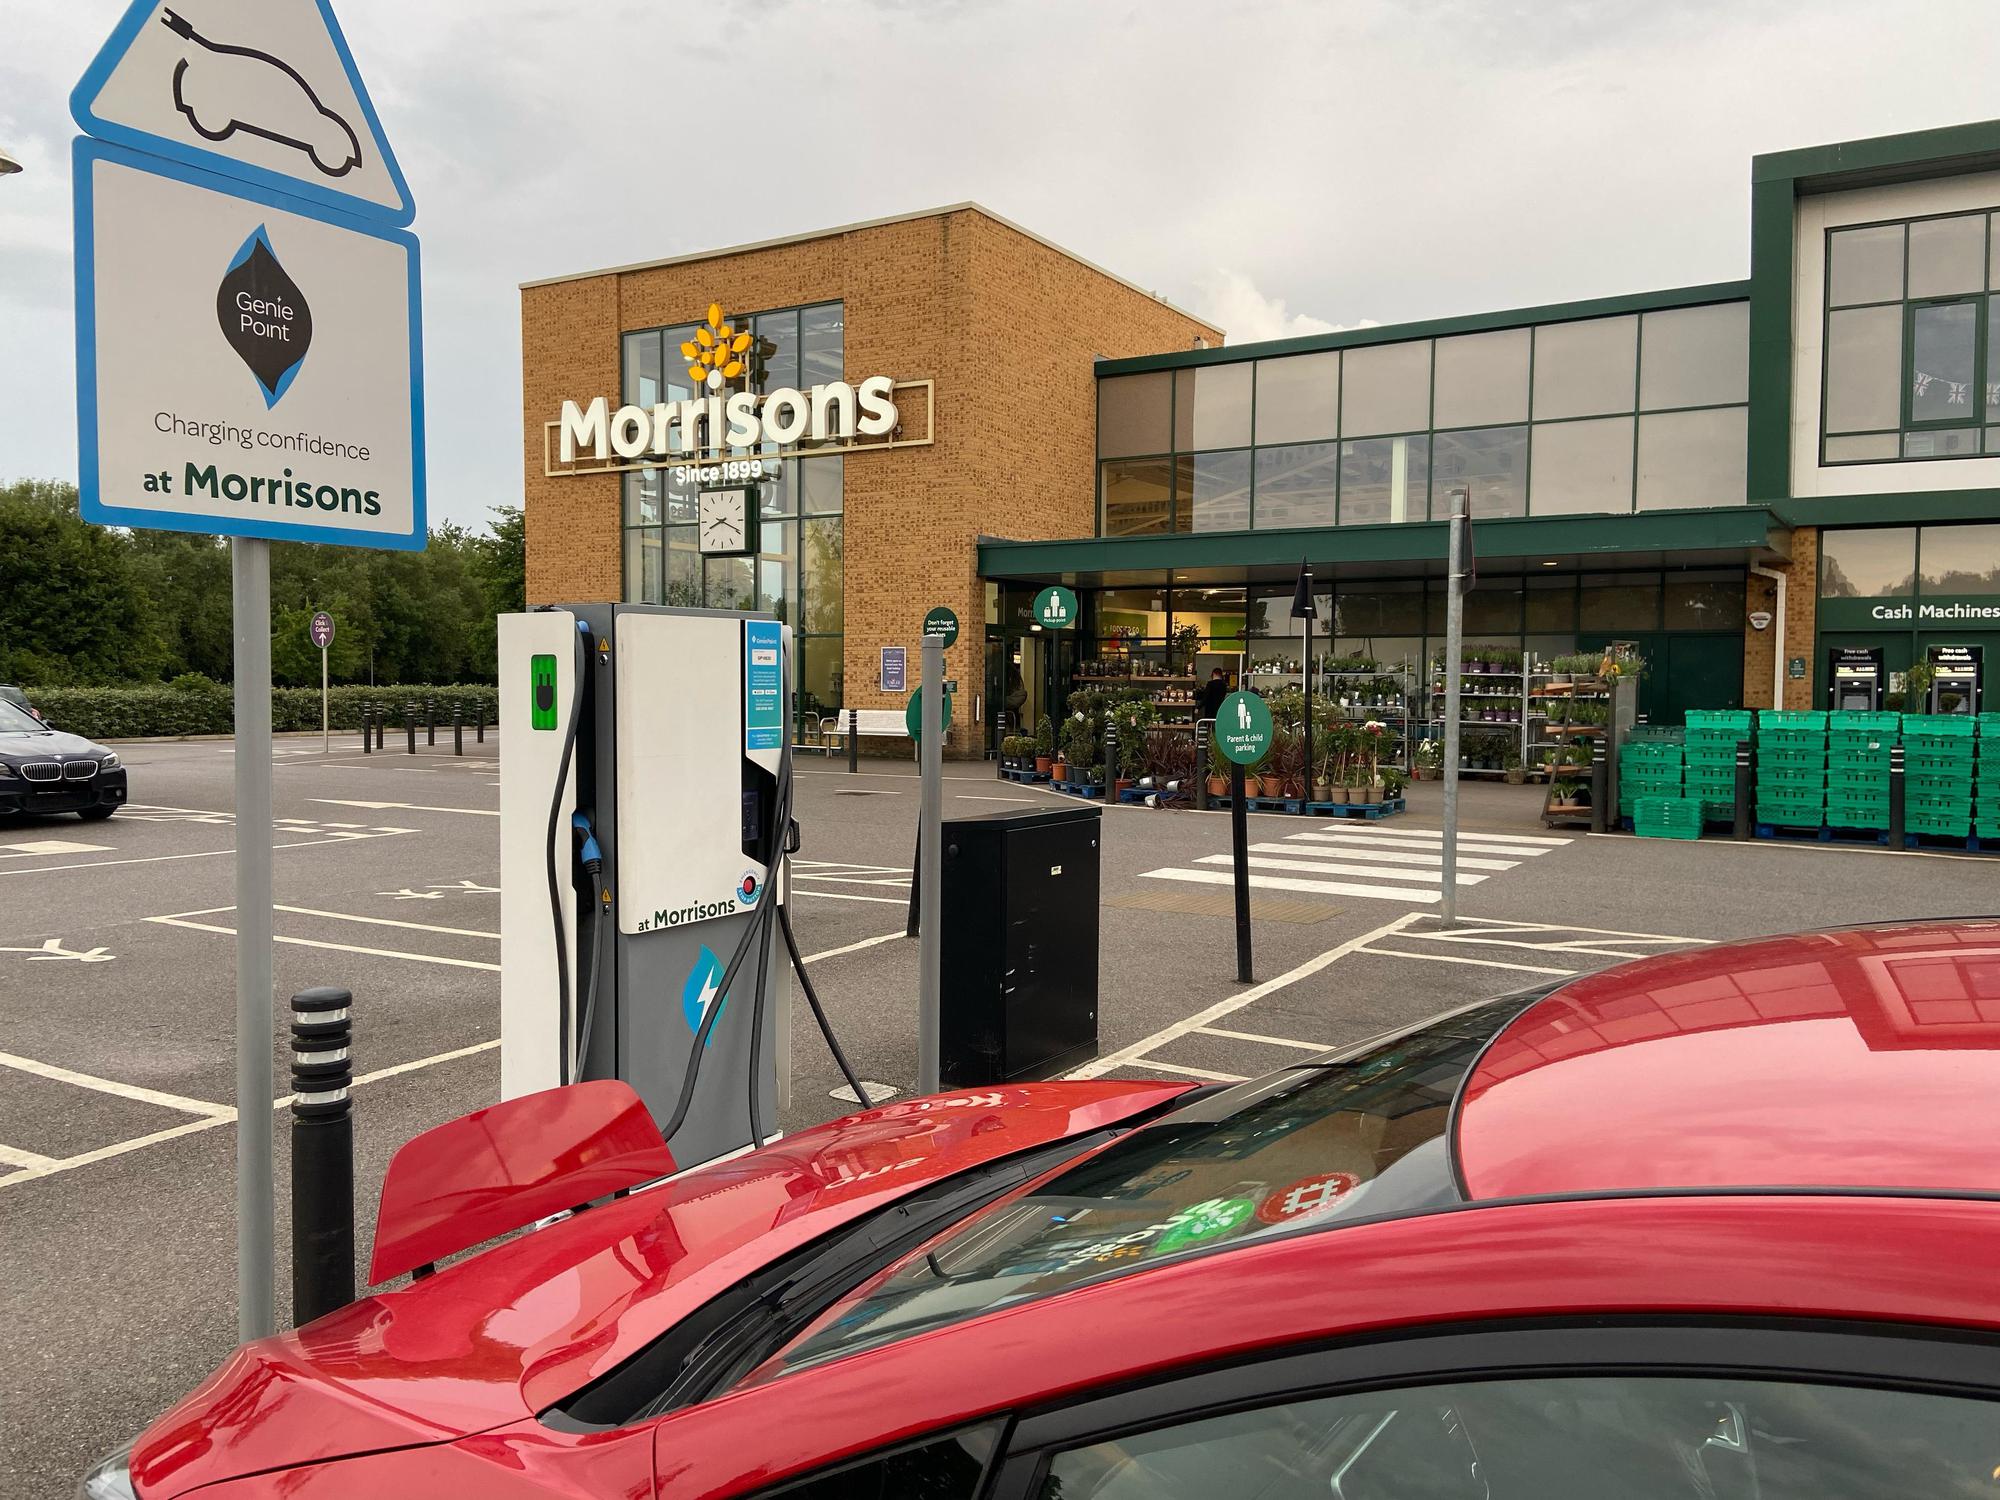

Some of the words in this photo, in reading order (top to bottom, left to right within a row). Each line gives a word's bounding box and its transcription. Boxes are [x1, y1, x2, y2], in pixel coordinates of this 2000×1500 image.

[236, 291, 294, 321] Genie
[240, 313, 290, 342] Point
[560, 370, 899, 462] Morrisons
[154, 411, 253, 449] Charging
[256, 431, 370, 461] confidence
[675, 464, 719, 484] Since
[721, 460, 763, 480] 1899
[143, 470, 173, 494] at
[184, 461, 382, 516] Morrisons
[1871, 603, 1913, 619] Cash
[1918, 603, 2000, 618] Machines
[1235, 743, 1255, 753] parking
[638, 919, 650, 932] at
[654, 899, 736, 929] Morrisons
